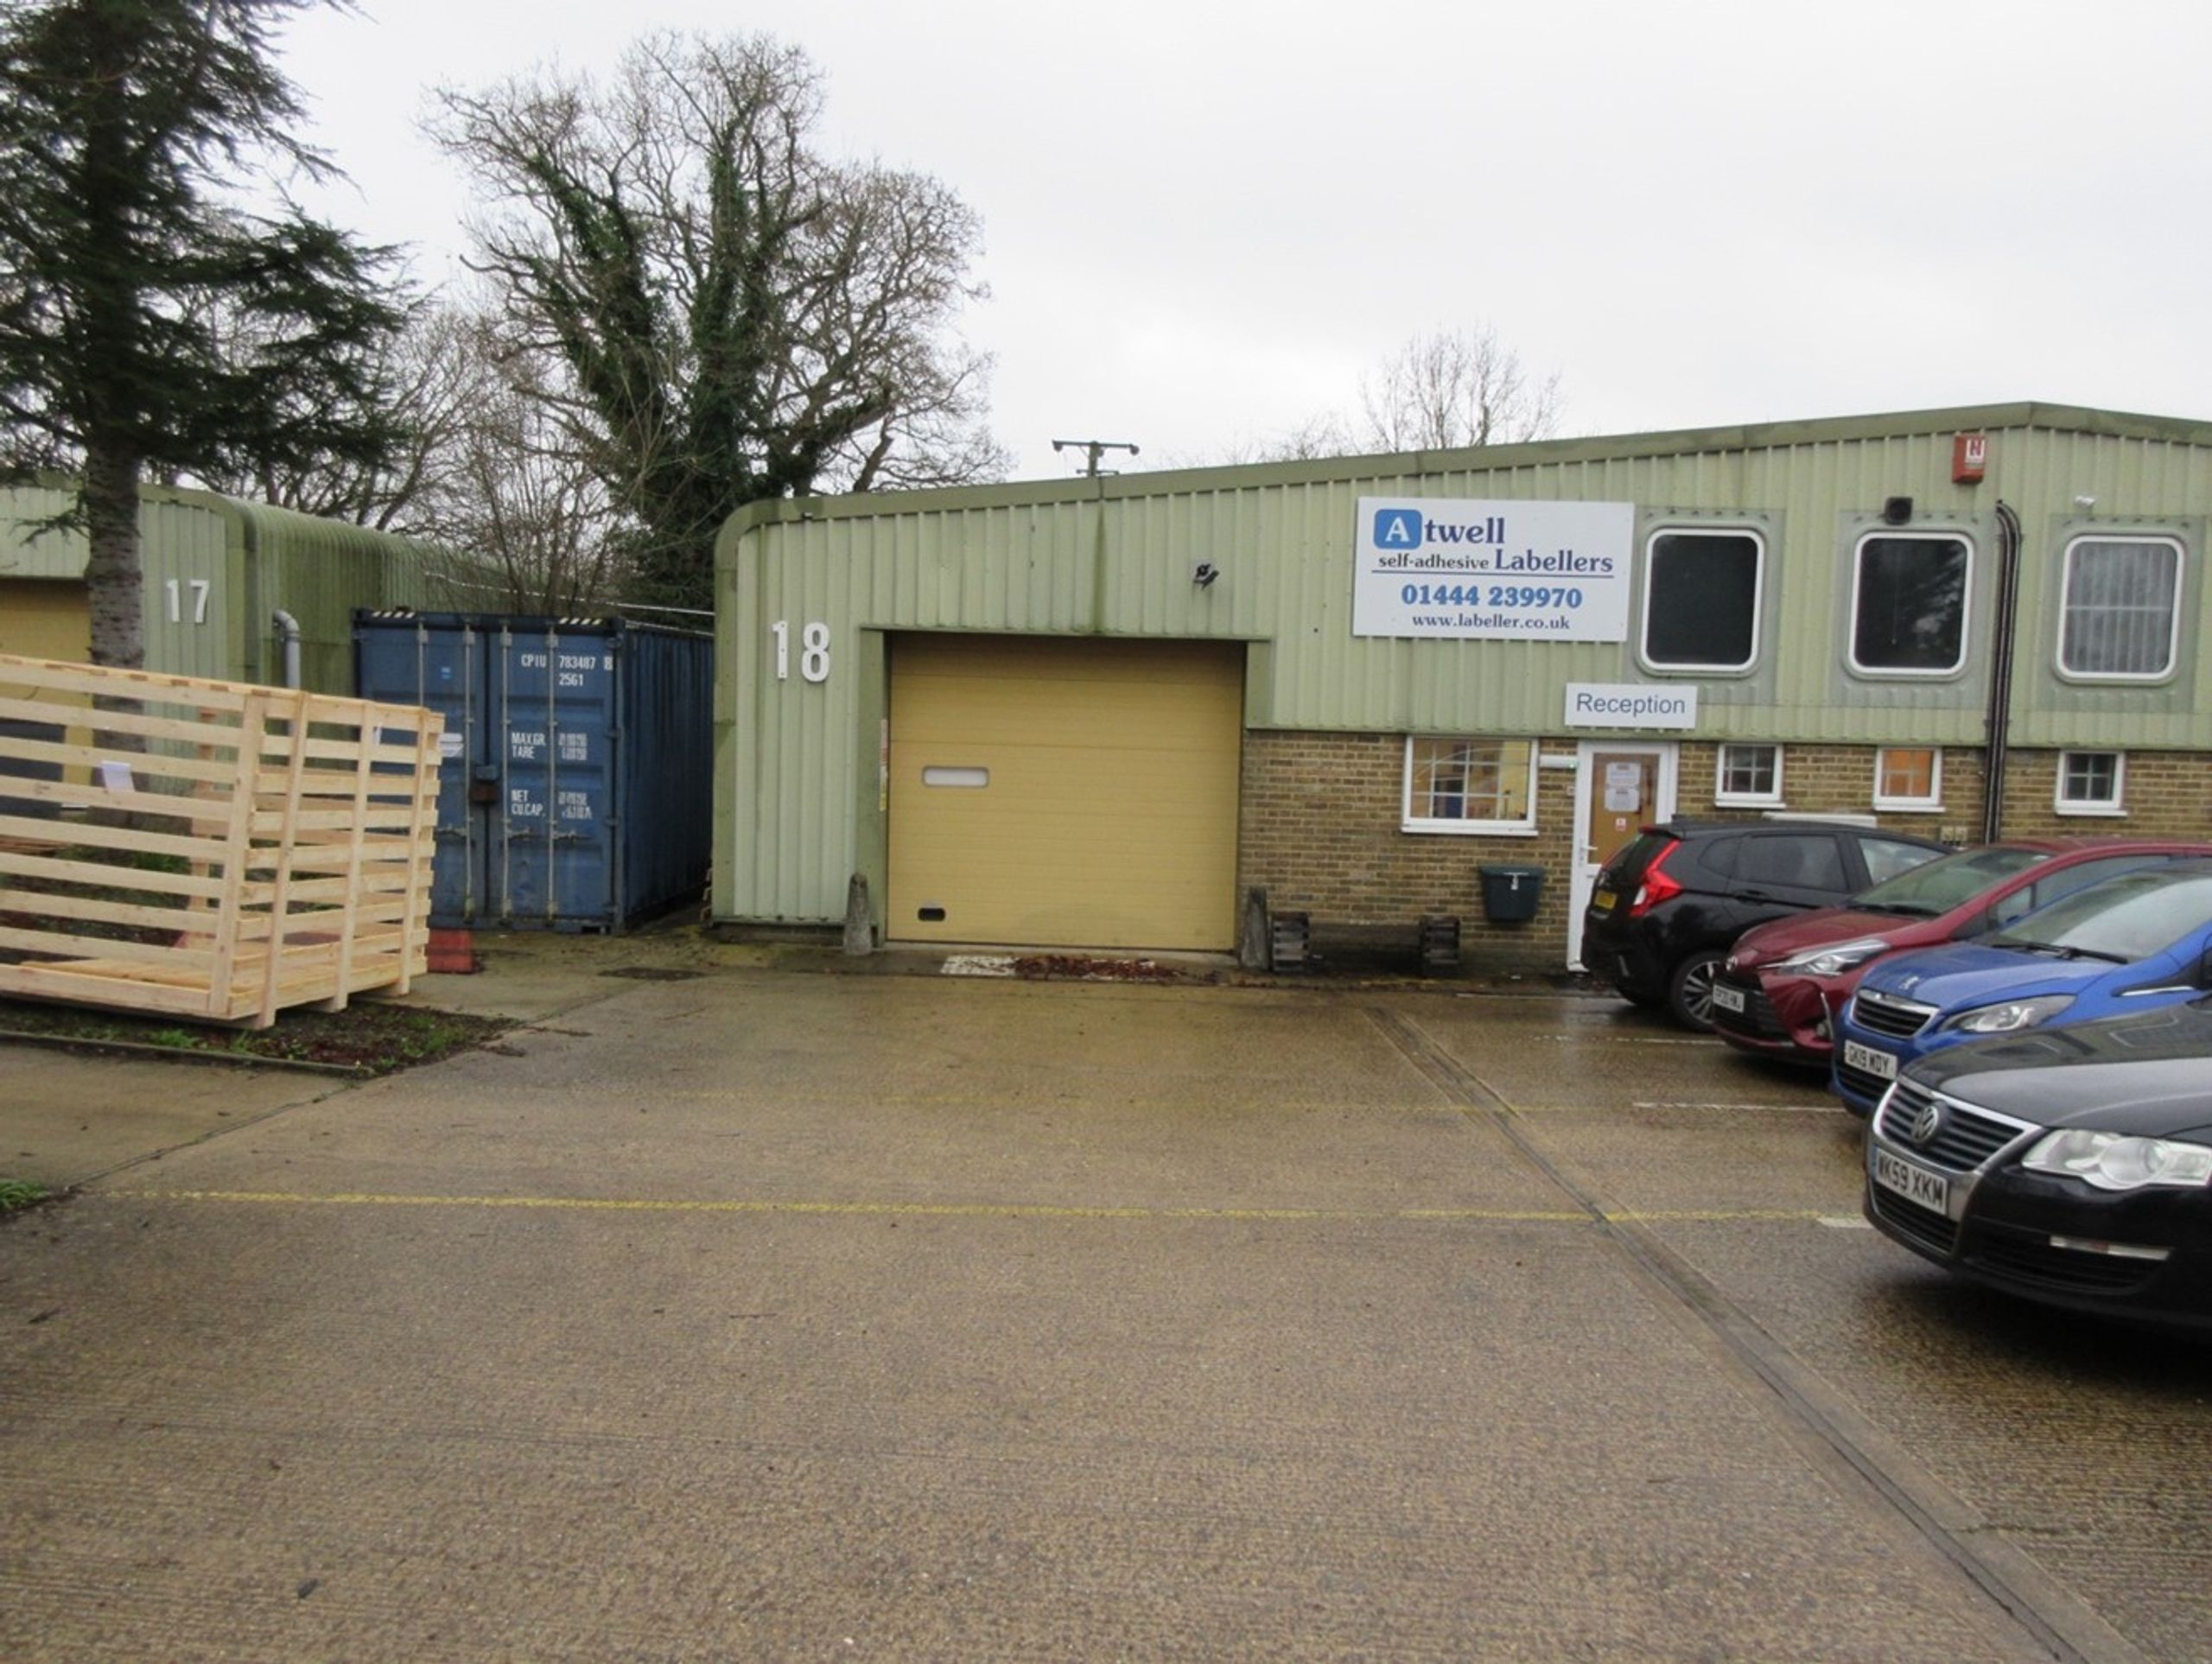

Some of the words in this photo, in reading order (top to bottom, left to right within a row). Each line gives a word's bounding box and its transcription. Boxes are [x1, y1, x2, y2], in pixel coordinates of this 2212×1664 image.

[1384, 517, 1505, 544] Atwell
[1378, 553, 1490, 570] self-adhesive
[1495, 549, 1614, 572] Labellers
[166, 578, 210, 623] 17
[1402, 584, 1479, 606] 01444
[1488, 586, 1582, 608] 239970
[1412, 613, 1570, 630] www.labeller.co.uk
[772, 620, 830, 682] 18
[1576, 693, 1685, 718] Reception
